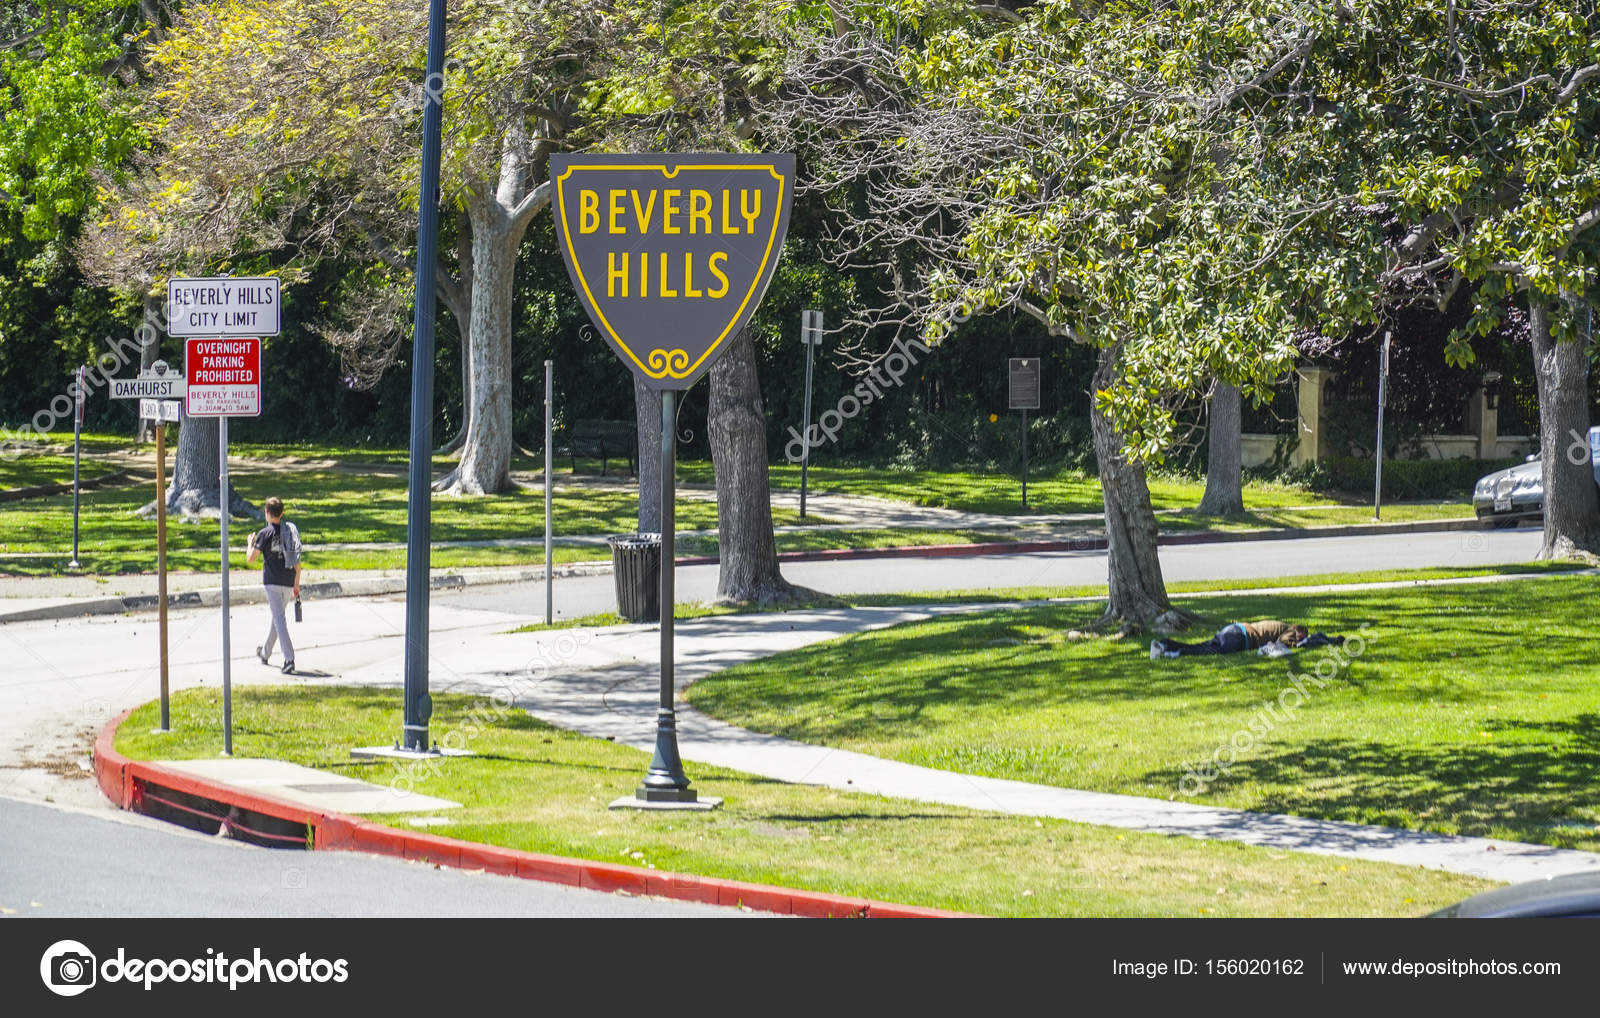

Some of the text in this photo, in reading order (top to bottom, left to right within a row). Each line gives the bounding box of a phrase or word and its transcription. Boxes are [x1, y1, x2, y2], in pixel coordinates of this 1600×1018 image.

[578, 188, 762, 235] BEVERLY
[606, 251, 731, 299] HILLS
[175, 286, 273, 306] BEVERLY HILLS
[189, 311, 258, 327] CITY LIMIT
[196, 342, 252, 355] OVERNIGHT
[202, 355, 245, 369] PARKING
[195, 369, 253, 383] PROHIBITED
[115, 380, 174, 396] OAKHURST
[191, 390, 256, 400] BEVERLY HILLS
